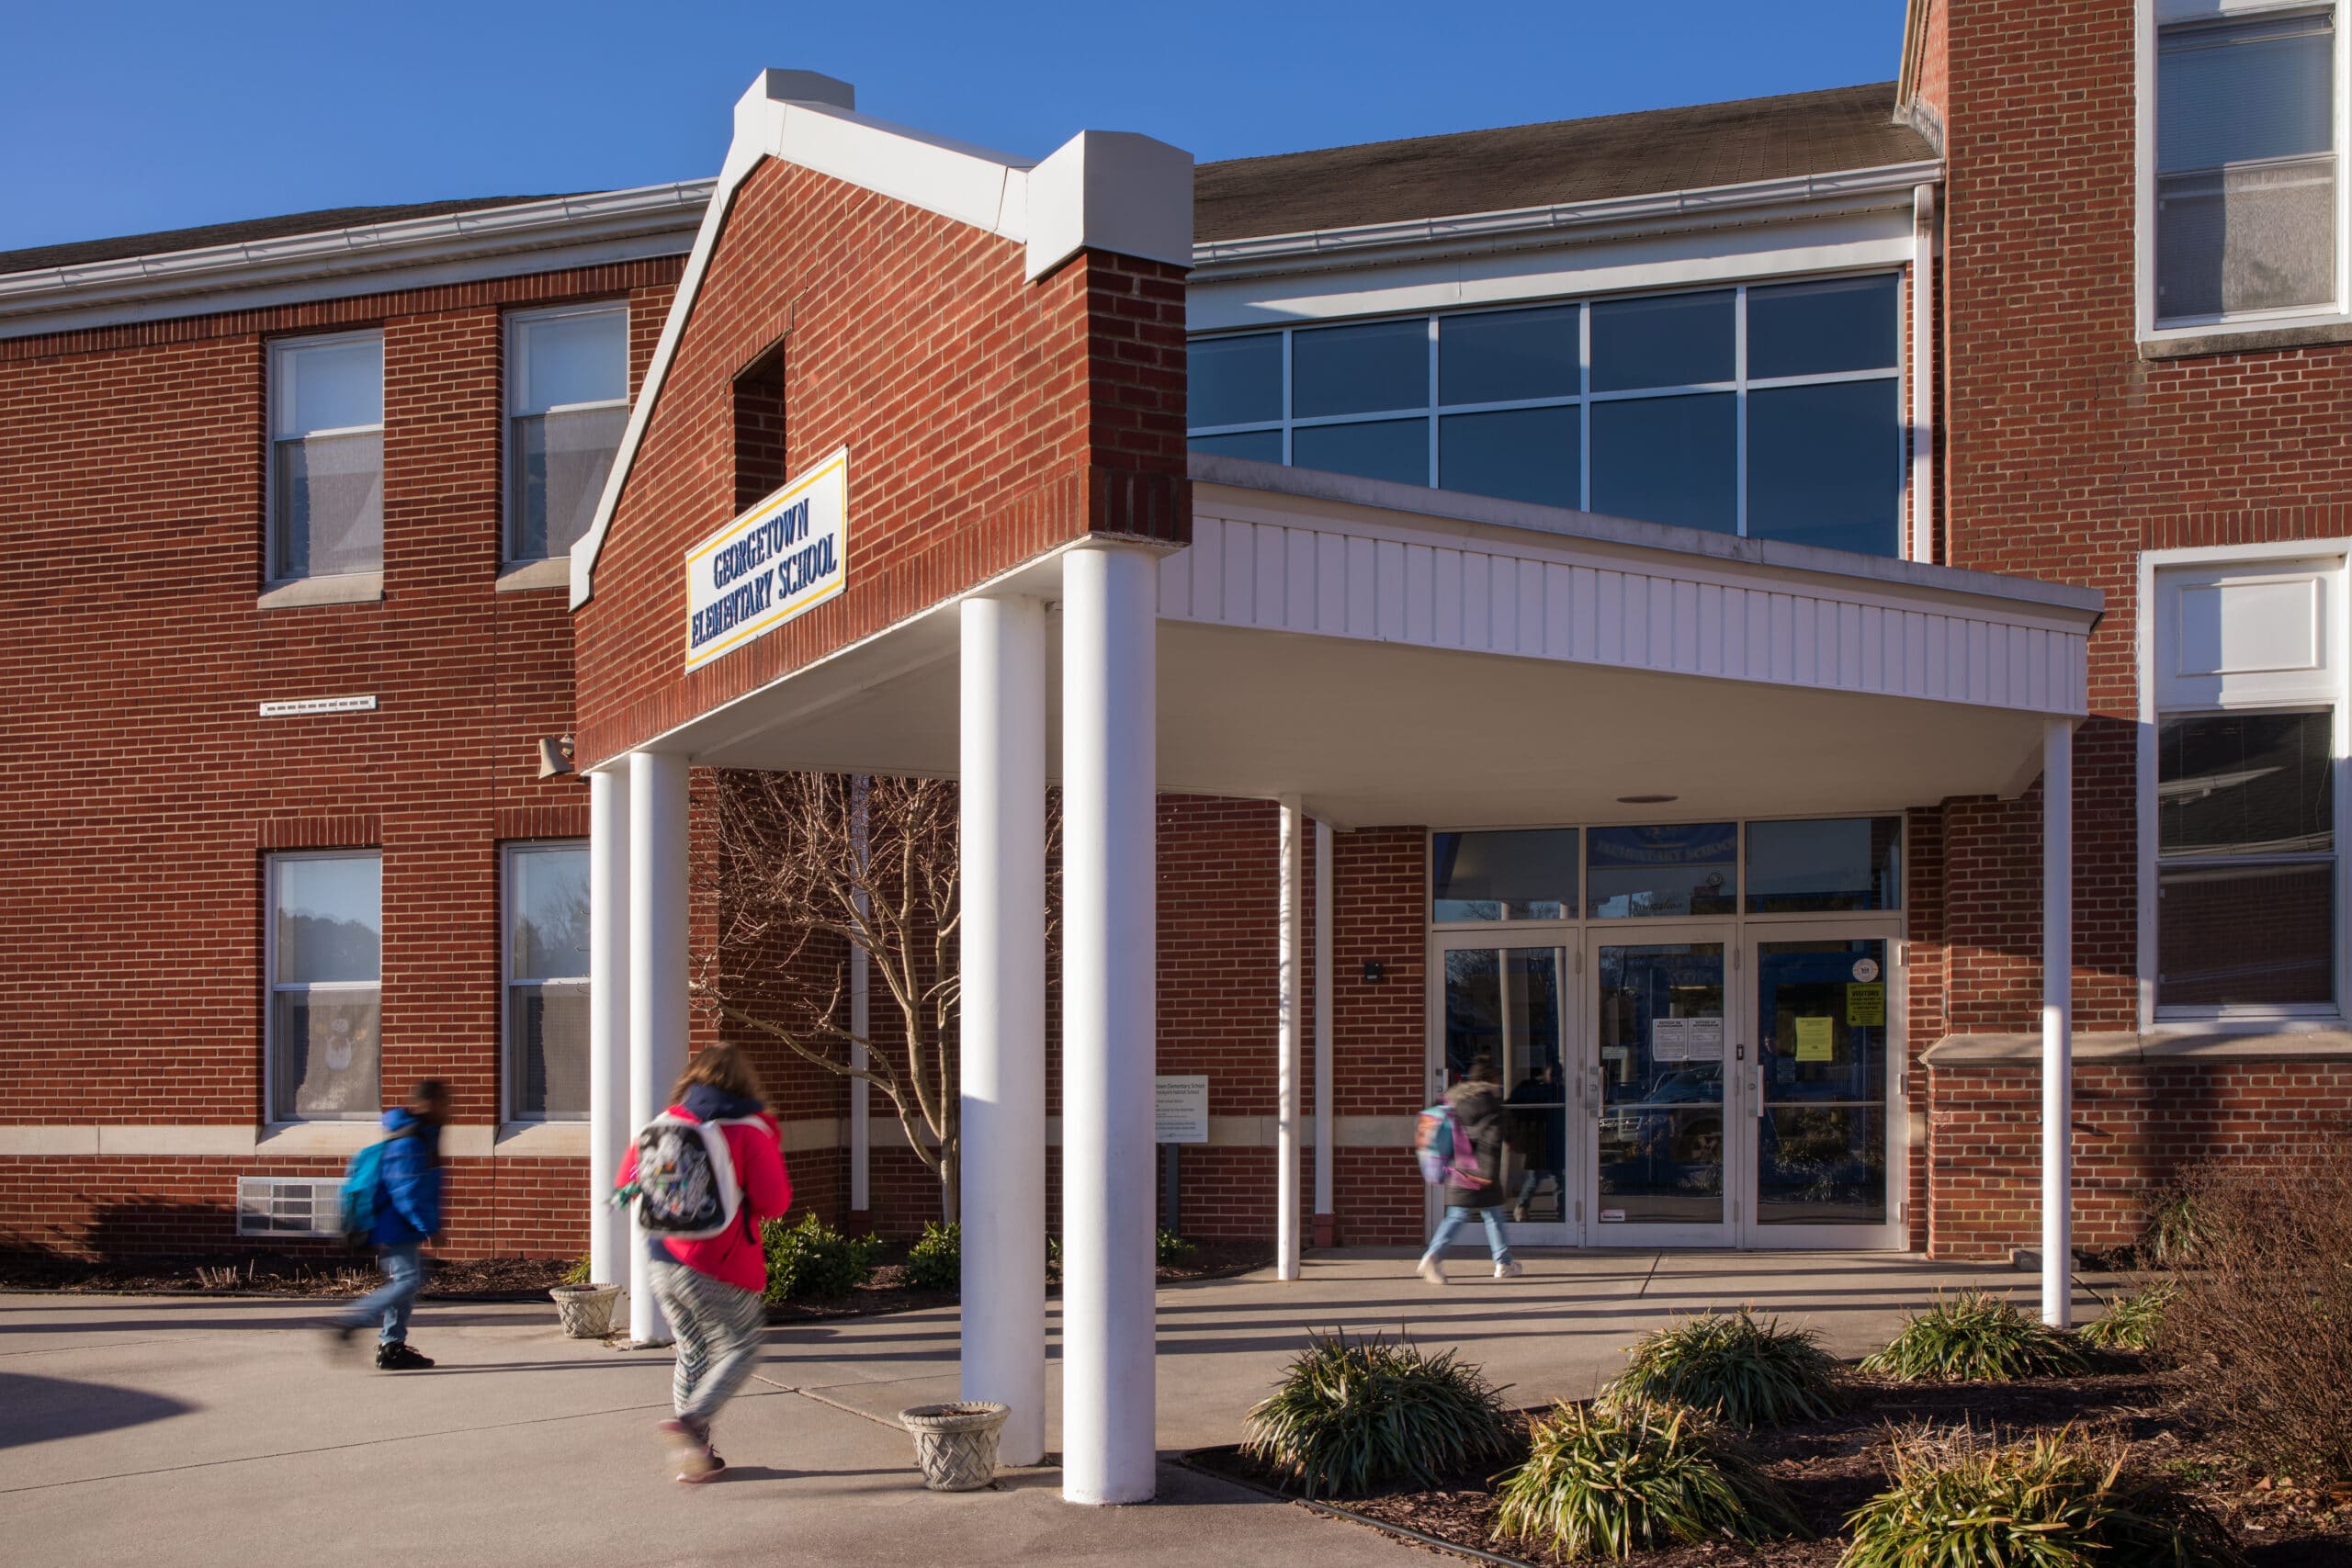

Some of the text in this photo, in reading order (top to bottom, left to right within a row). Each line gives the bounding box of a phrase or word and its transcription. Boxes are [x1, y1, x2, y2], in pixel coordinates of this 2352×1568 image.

[691, 533, 838, 649] ELEMENTARY SCHOOL
[713, 497, 809, 590] GEORGETOWN
